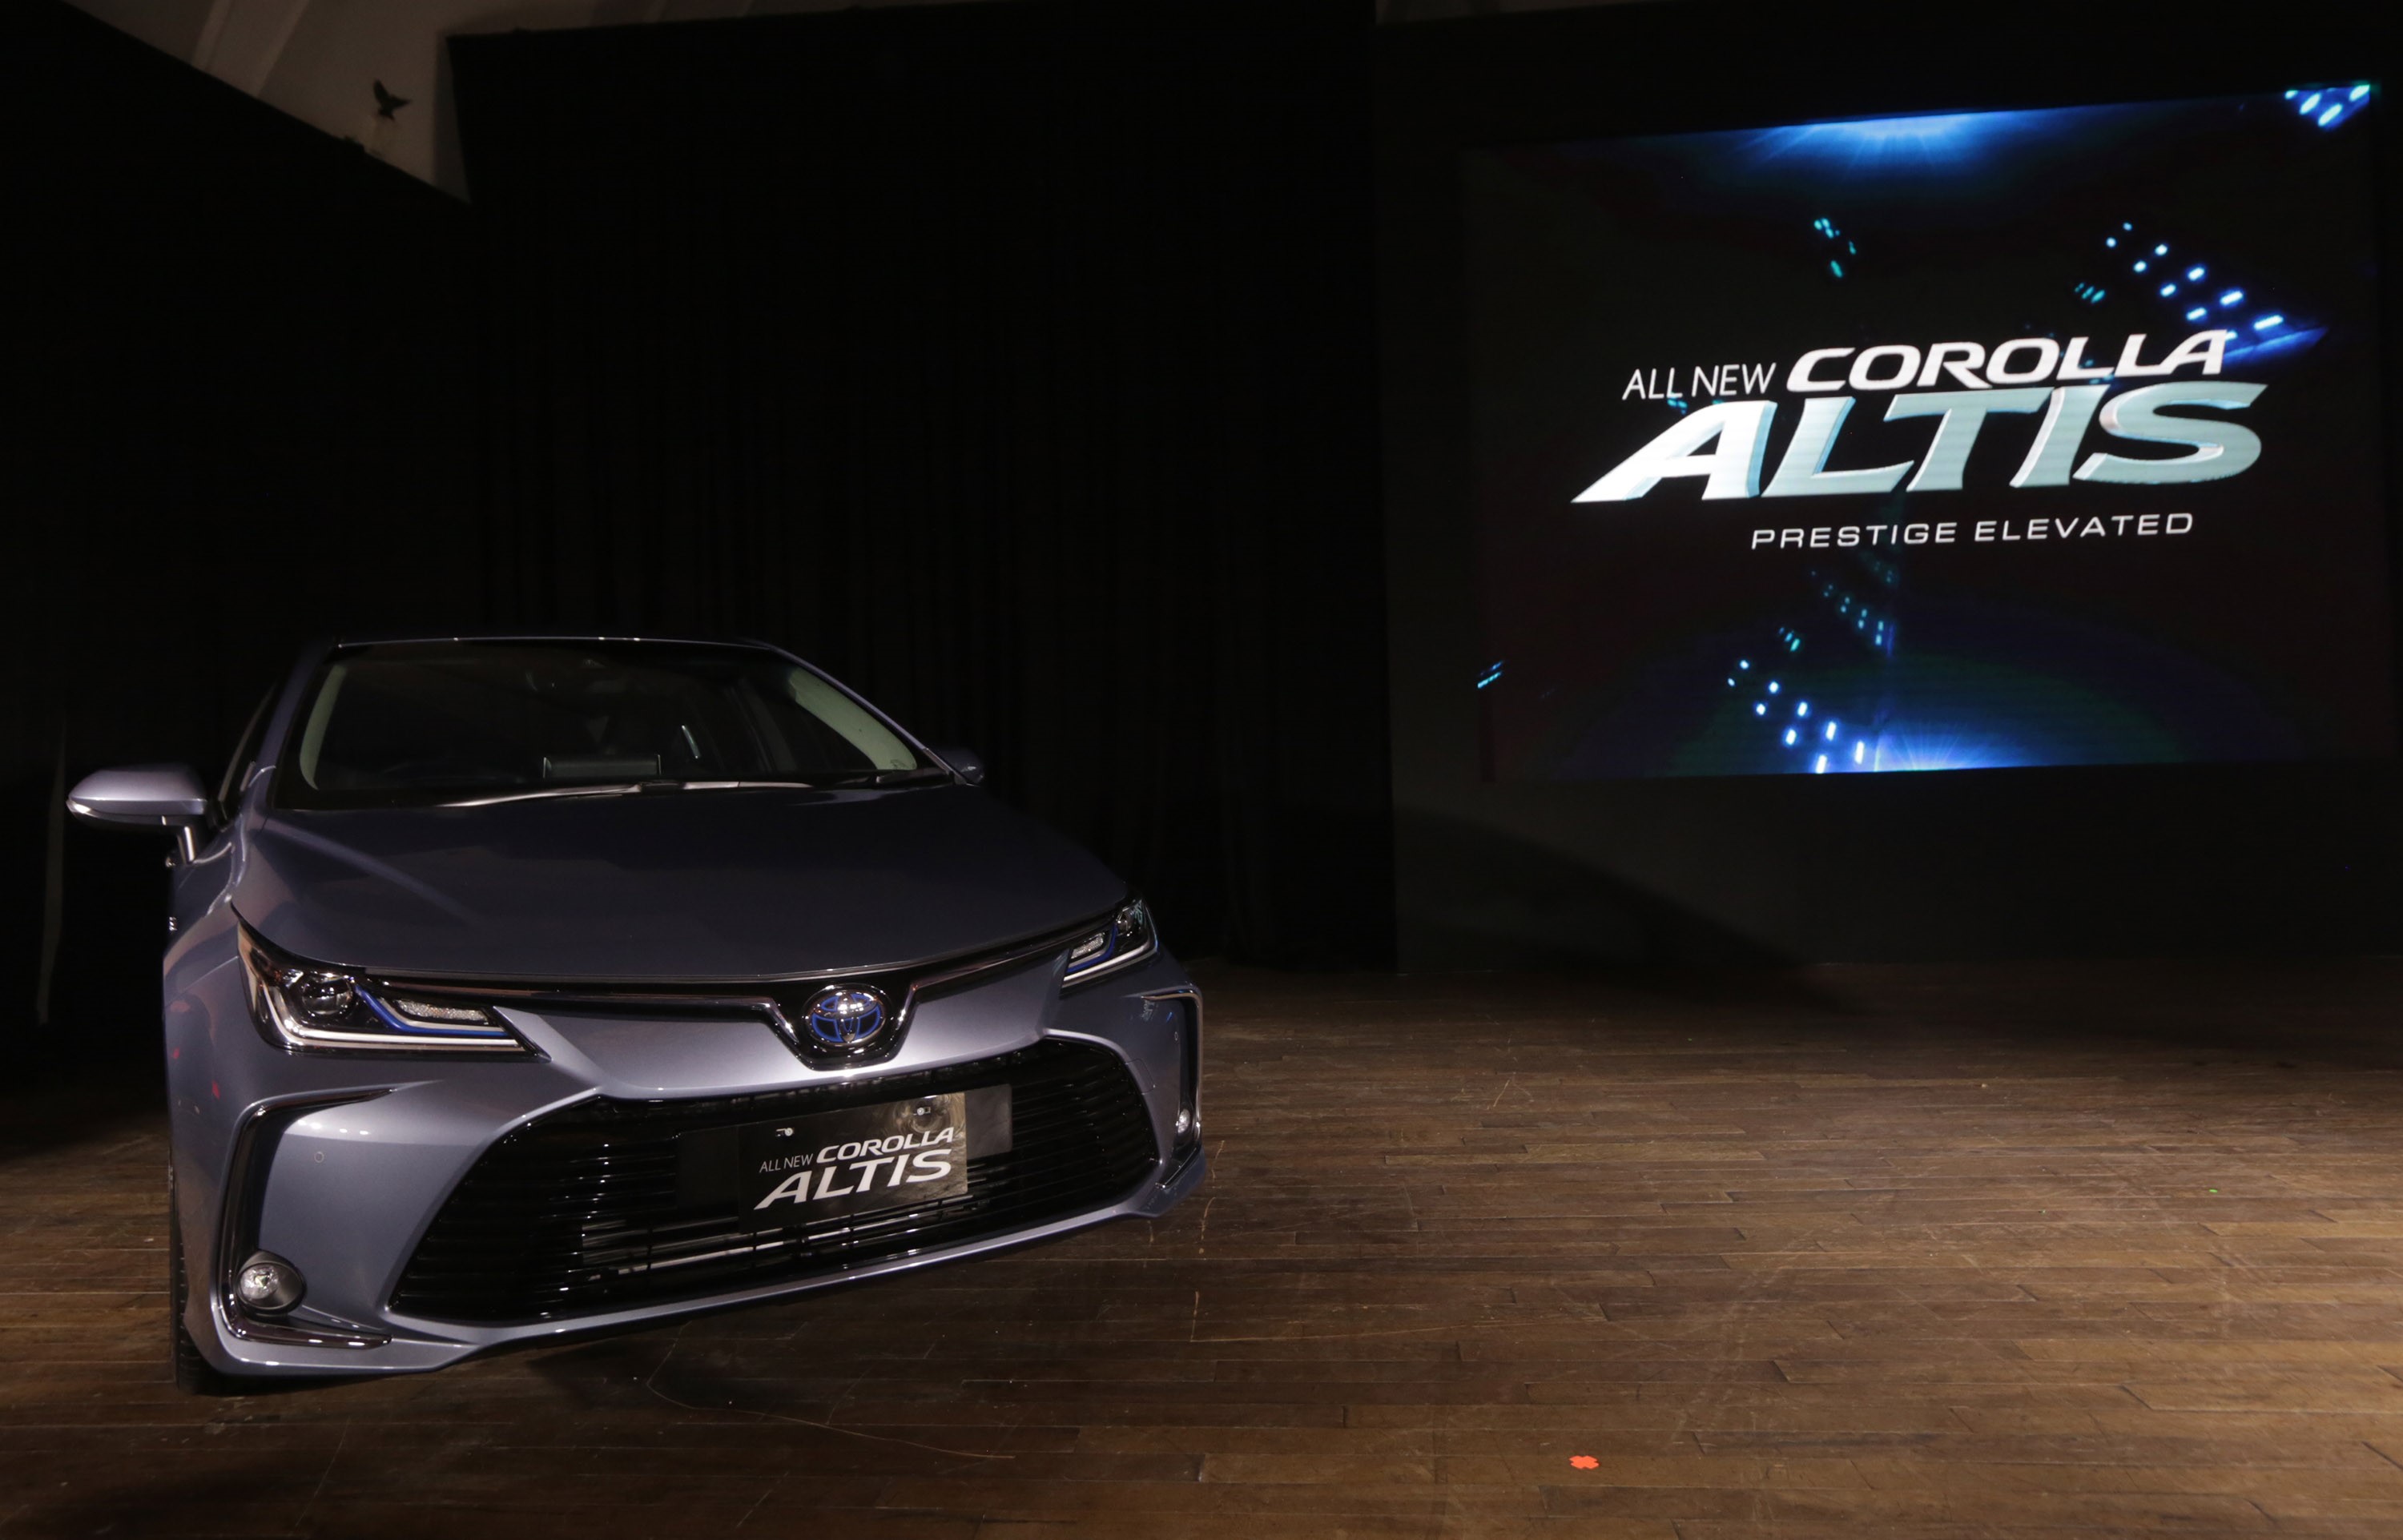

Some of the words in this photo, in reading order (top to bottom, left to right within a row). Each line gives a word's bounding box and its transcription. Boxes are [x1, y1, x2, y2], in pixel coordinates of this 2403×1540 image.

[1622, 368, 1683, 400] ALL
[1692, 362, 1777, 397] NEW
[1786, 329, 2228, 392] COROLLA
[1571, 381, 2268, 503] ALTIS
[1752, 522, 1958, 549] PRESTIGE
[1974, 513, 2193, 541] ELEVATED
[754, 1148, 952, 1210] ALTIS
[759, 1160, 782, 1173] ALL
[783, 1153, 813, 1169] NEW
[816, 1127, 954, 1164] COROLLA
